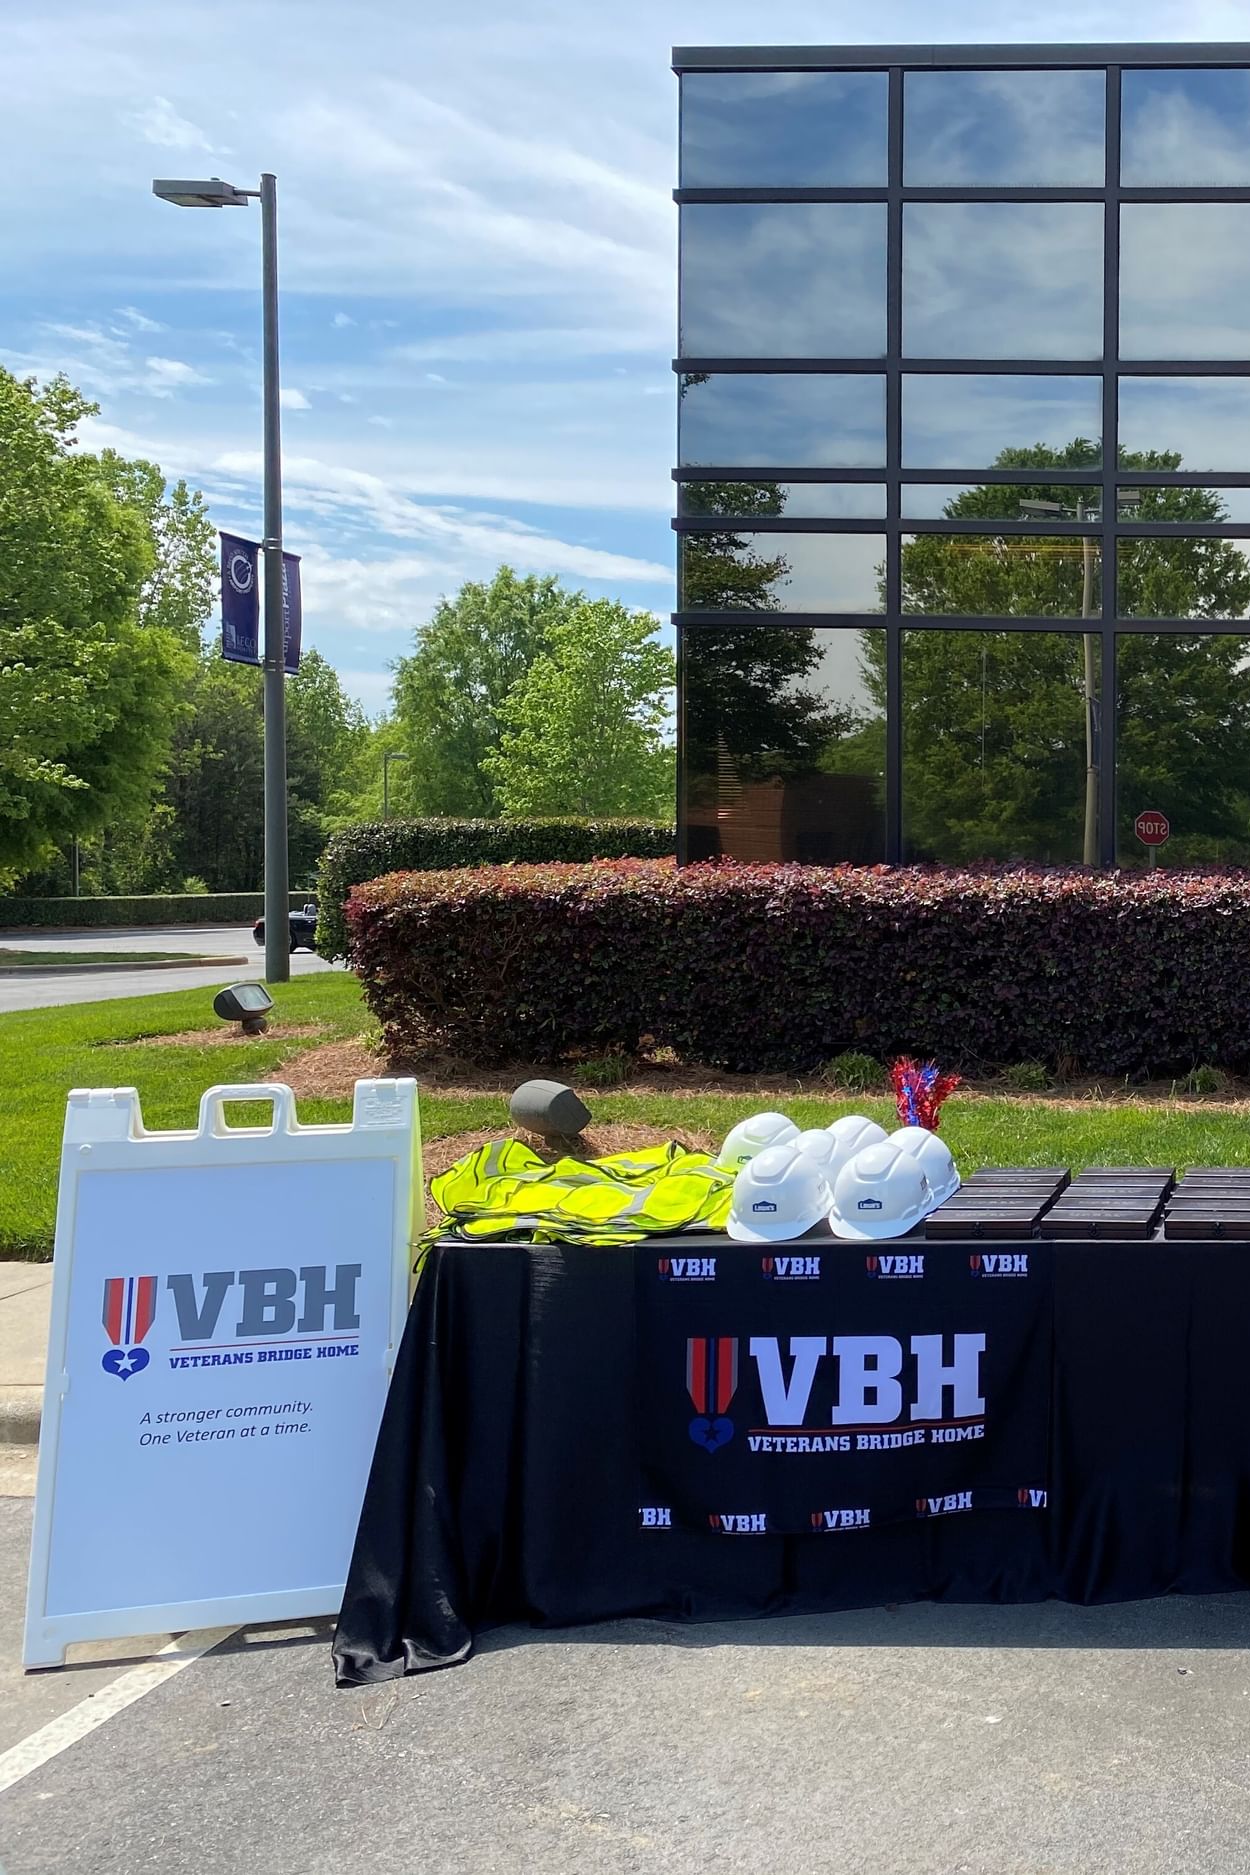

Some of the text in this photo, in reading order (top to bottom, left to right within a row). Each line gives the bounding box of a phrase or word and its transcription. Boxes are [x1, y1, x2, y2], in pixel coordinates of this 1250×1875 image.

[670, 1258, 716, 1276] VBH
[774, 1257, 820, 1275] VBH
[878, 1256, 924, 1273] VBH
[982, 1255, 1028, 1272] VBH
[166, 1264, 362, 1341] VBH
[168, 1344, 360, 1370] VETERANS BRIDGE HOME
[749, 1333, 986, 1426] VBH
[139, 1400, 314, 1428] A stronger community.
[138, 1421, 312, 1446] One Veteran at a time.
[748, 1424, 986, 1454] VETERANS BRIDGE HOME
[928, 1491, 972, 1512] VBH
[638, 1508, 672, 1526] BH
[720, 1514, 766, 1532] VBH
[824, 1508, 870, 1528] VBH
